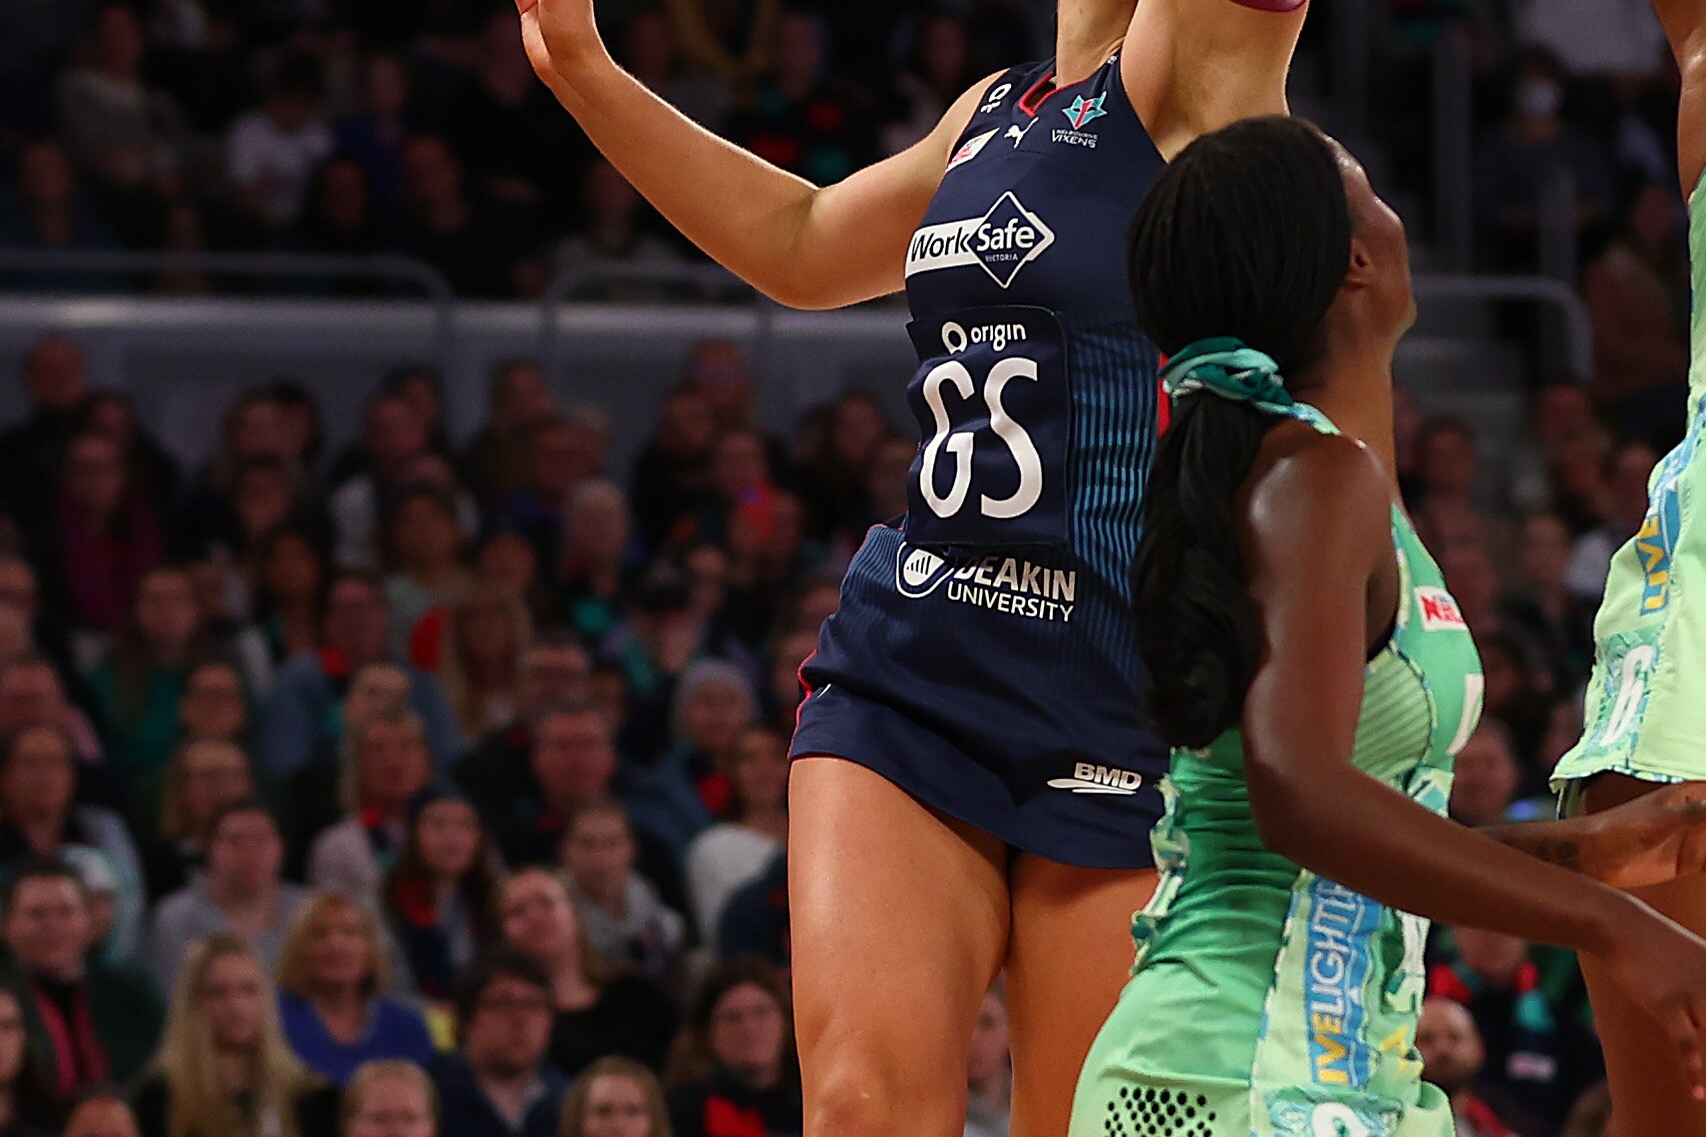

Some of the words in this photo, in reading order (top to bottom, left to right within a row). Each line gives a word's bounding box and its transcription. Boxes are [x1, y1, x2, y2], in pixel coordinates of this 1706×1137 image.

[1051, 129, 1097, 149] VIXENS
[970, 322, 1027, 351] origin
[919, 357, 1044, 520] GS
[953, 555, 1077, 602] DEAKIN
[947, 580, 1075, 622] UNIVERSITY
[1073, 761, 1142, 791] BMD
